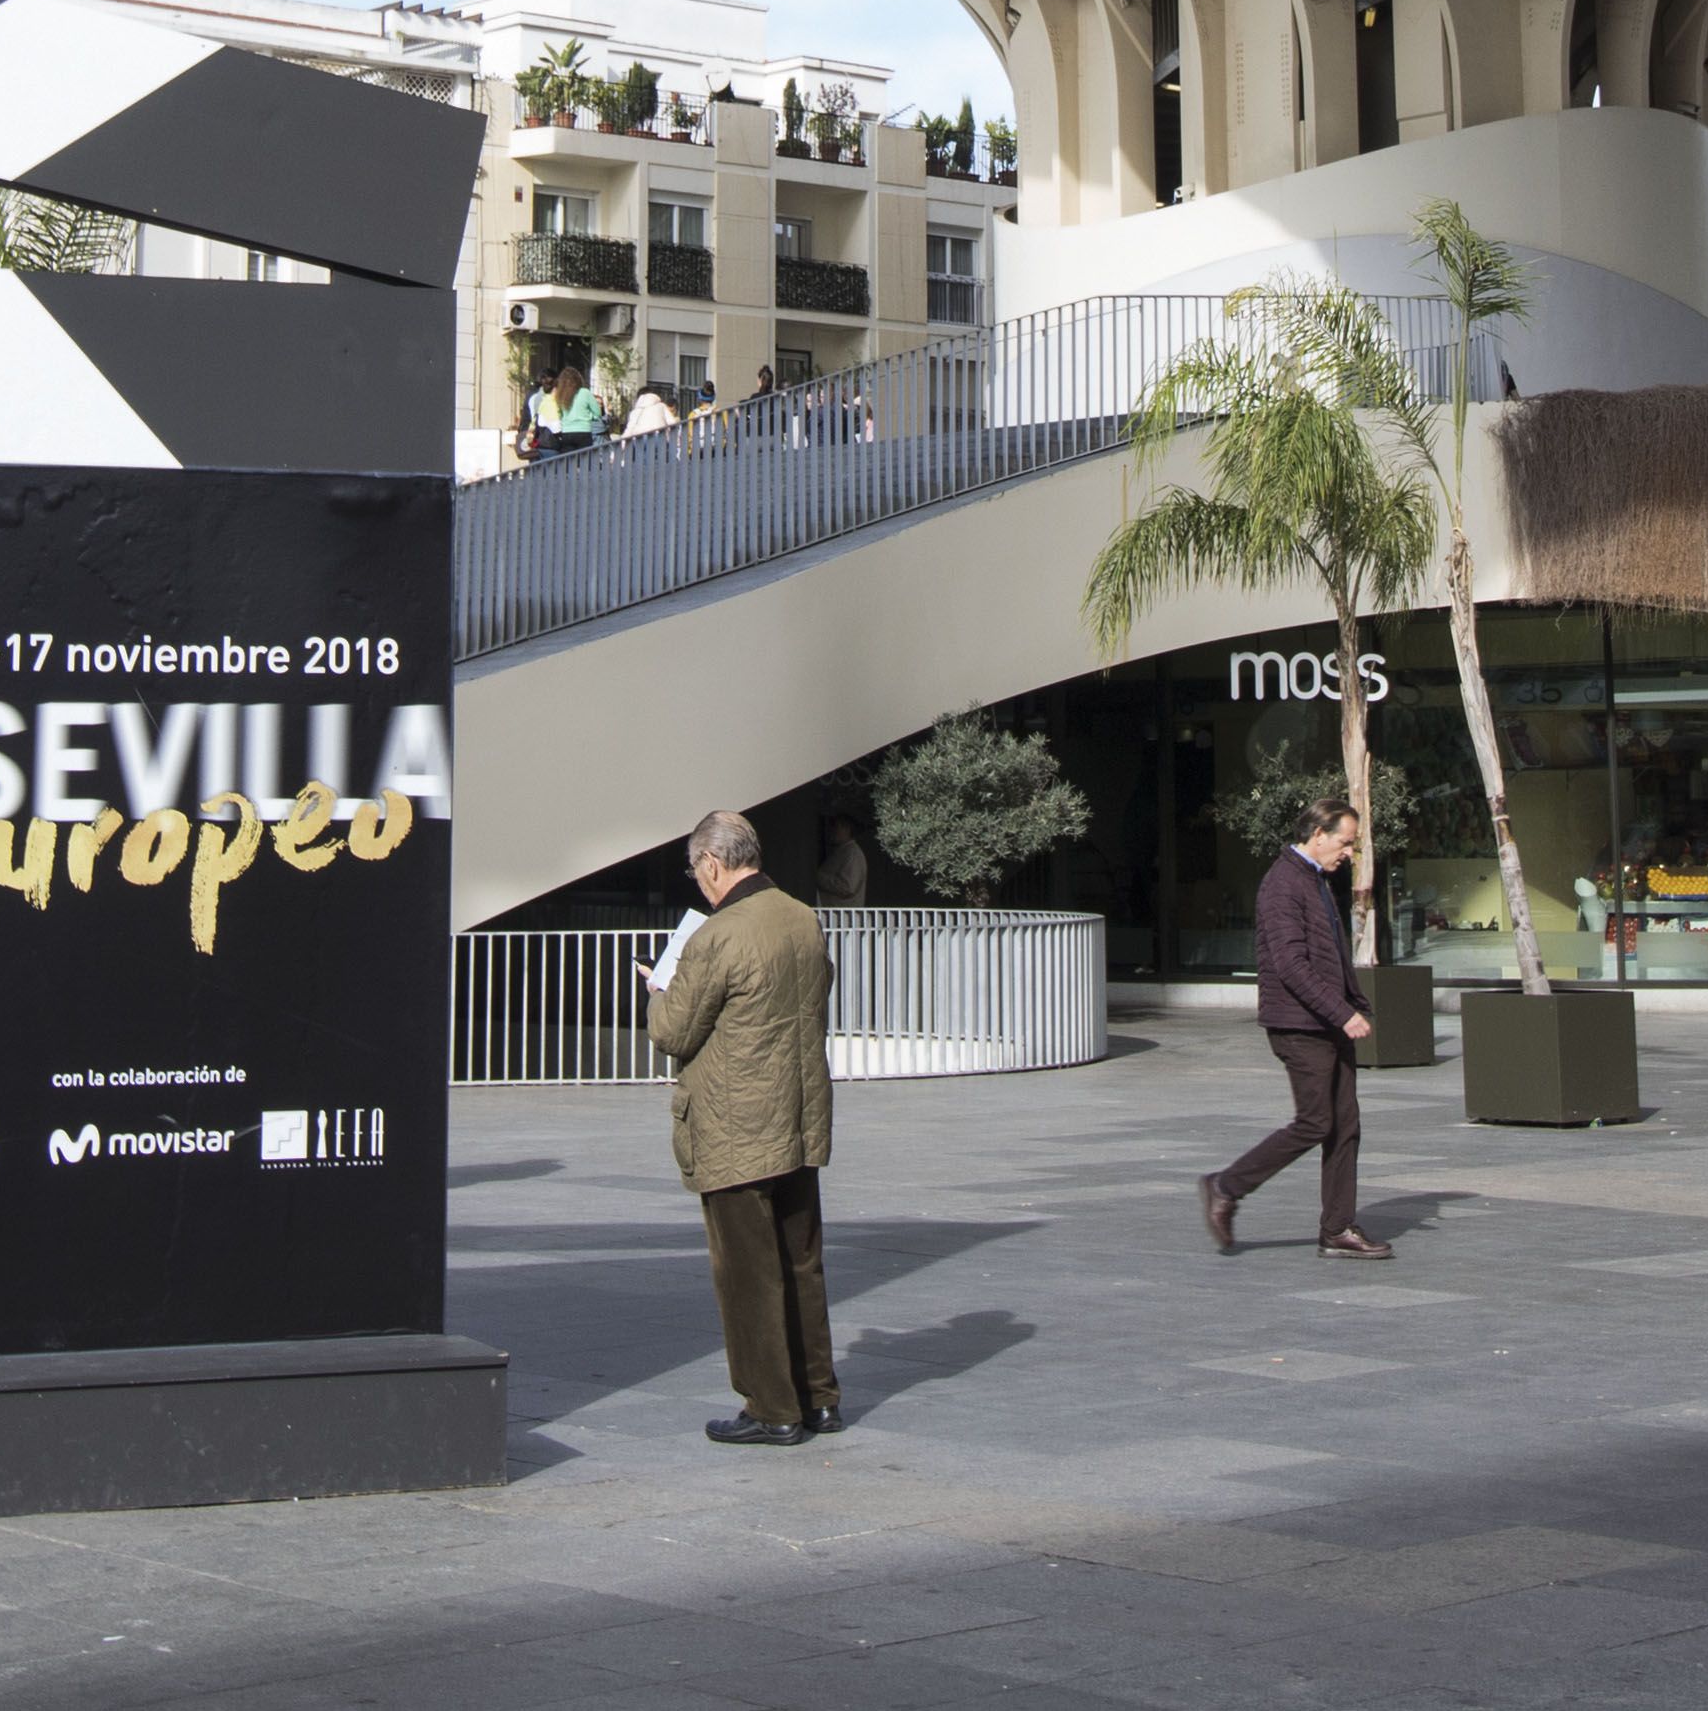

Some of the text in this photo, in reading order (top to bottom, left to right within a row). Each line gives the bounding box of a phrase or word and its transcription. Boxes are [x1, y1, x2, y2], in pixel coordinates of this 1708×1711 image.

[67, 635, 291, 675] noviembre
[304, 637, 401, 675] 2018
[1230, 650, 1389, 702] moss
[52, 1065, 246, 1087] con la colaboración de
[108, 1127, 235, 1156] movistar
